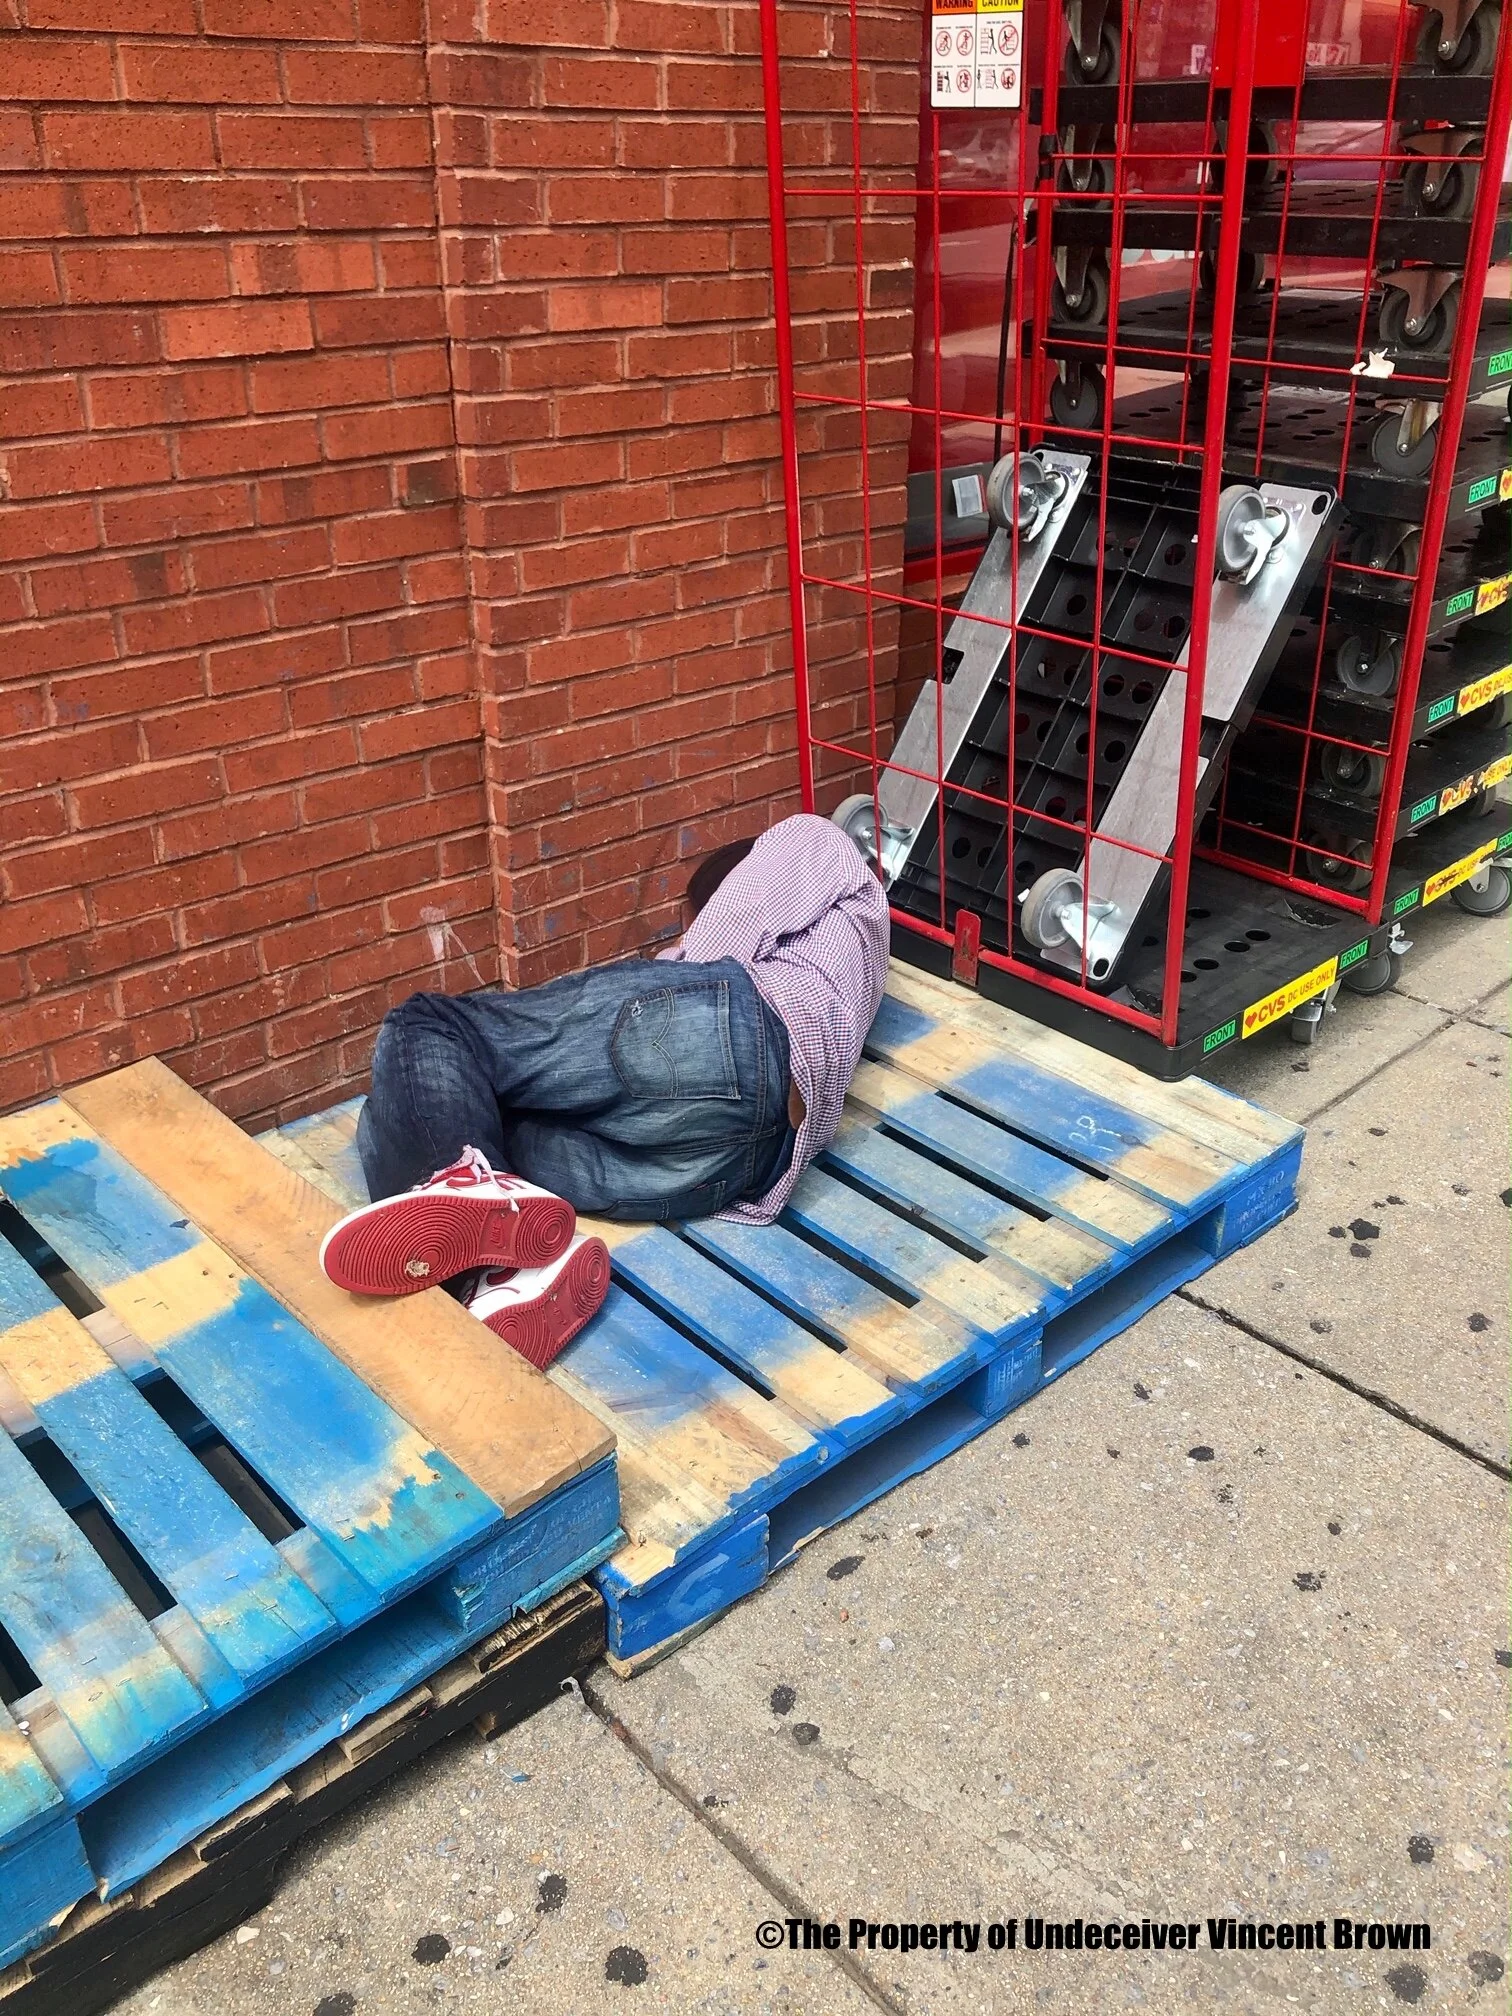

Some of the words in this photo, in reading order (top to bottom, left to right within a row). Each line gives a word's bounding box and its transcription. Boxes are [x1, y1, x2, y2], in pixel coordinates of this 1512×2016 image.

[1470, 479, 1496, 502] FRONT
[1448, 594, 1472, 615] FRONT
[1470, 682, 1492, 705] CVS
[1429, 698, 1454, 722] FRONT
[1411, 798, 1436, 822] FRONT
[1395, 889, 1419, 913] FRONT
[1340, 940, 1368, 967] FRONT
[1258, 994, 1286, 1023] CVS
[1288, 991, 1299, 1004] DC
[1299, 981, 1315, 996] USE
[1316, 967, 1335, 986] ONLY
[1204, 1021, 1235, 1051] FRONT
